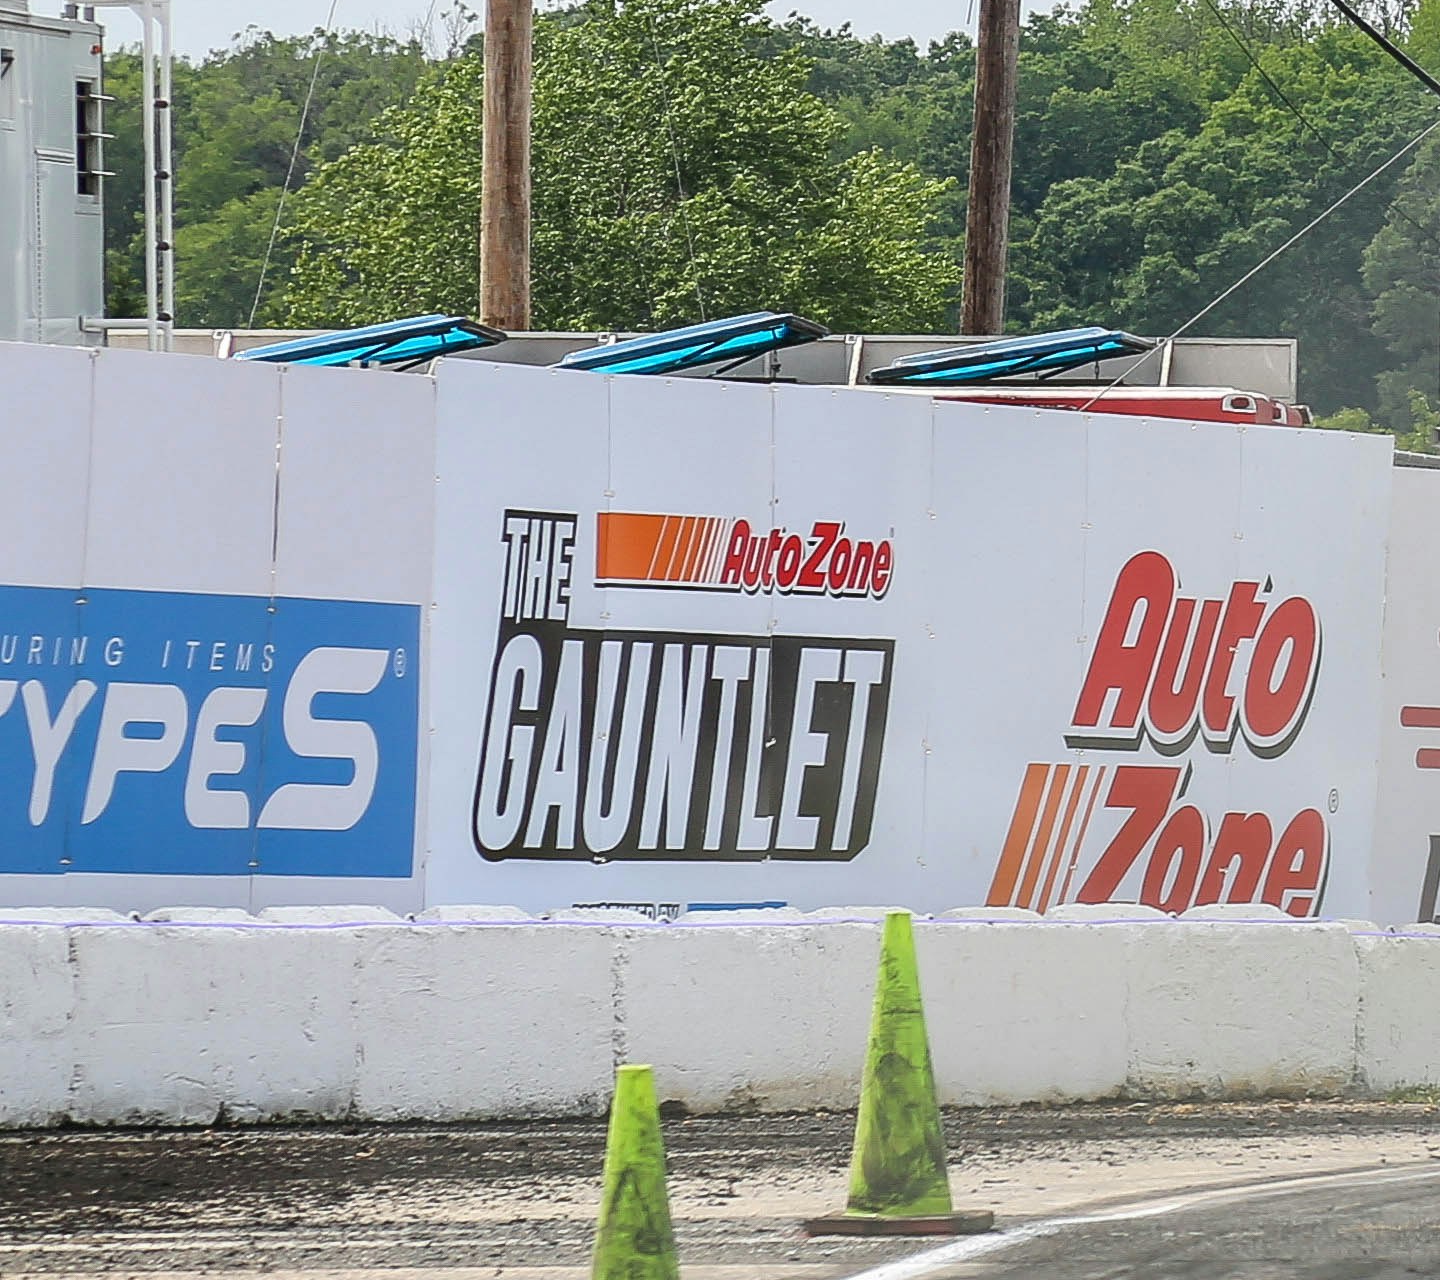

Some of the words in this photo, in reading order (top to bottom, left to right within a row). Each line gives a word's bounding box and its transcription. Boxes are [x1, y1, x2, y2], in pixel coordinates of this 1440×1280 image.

[502, 517, 575, 622] THE
[719, 519, 893, 595] AutoZone
[160, 639, 278, 673] ITEMS
[1067, 550, 1320, 752] Auto
[0, 645, 391, 832] YPES
[476, 633, 887, 852] GAUNTLET
[1075, 765, 1325, 918] Zone
